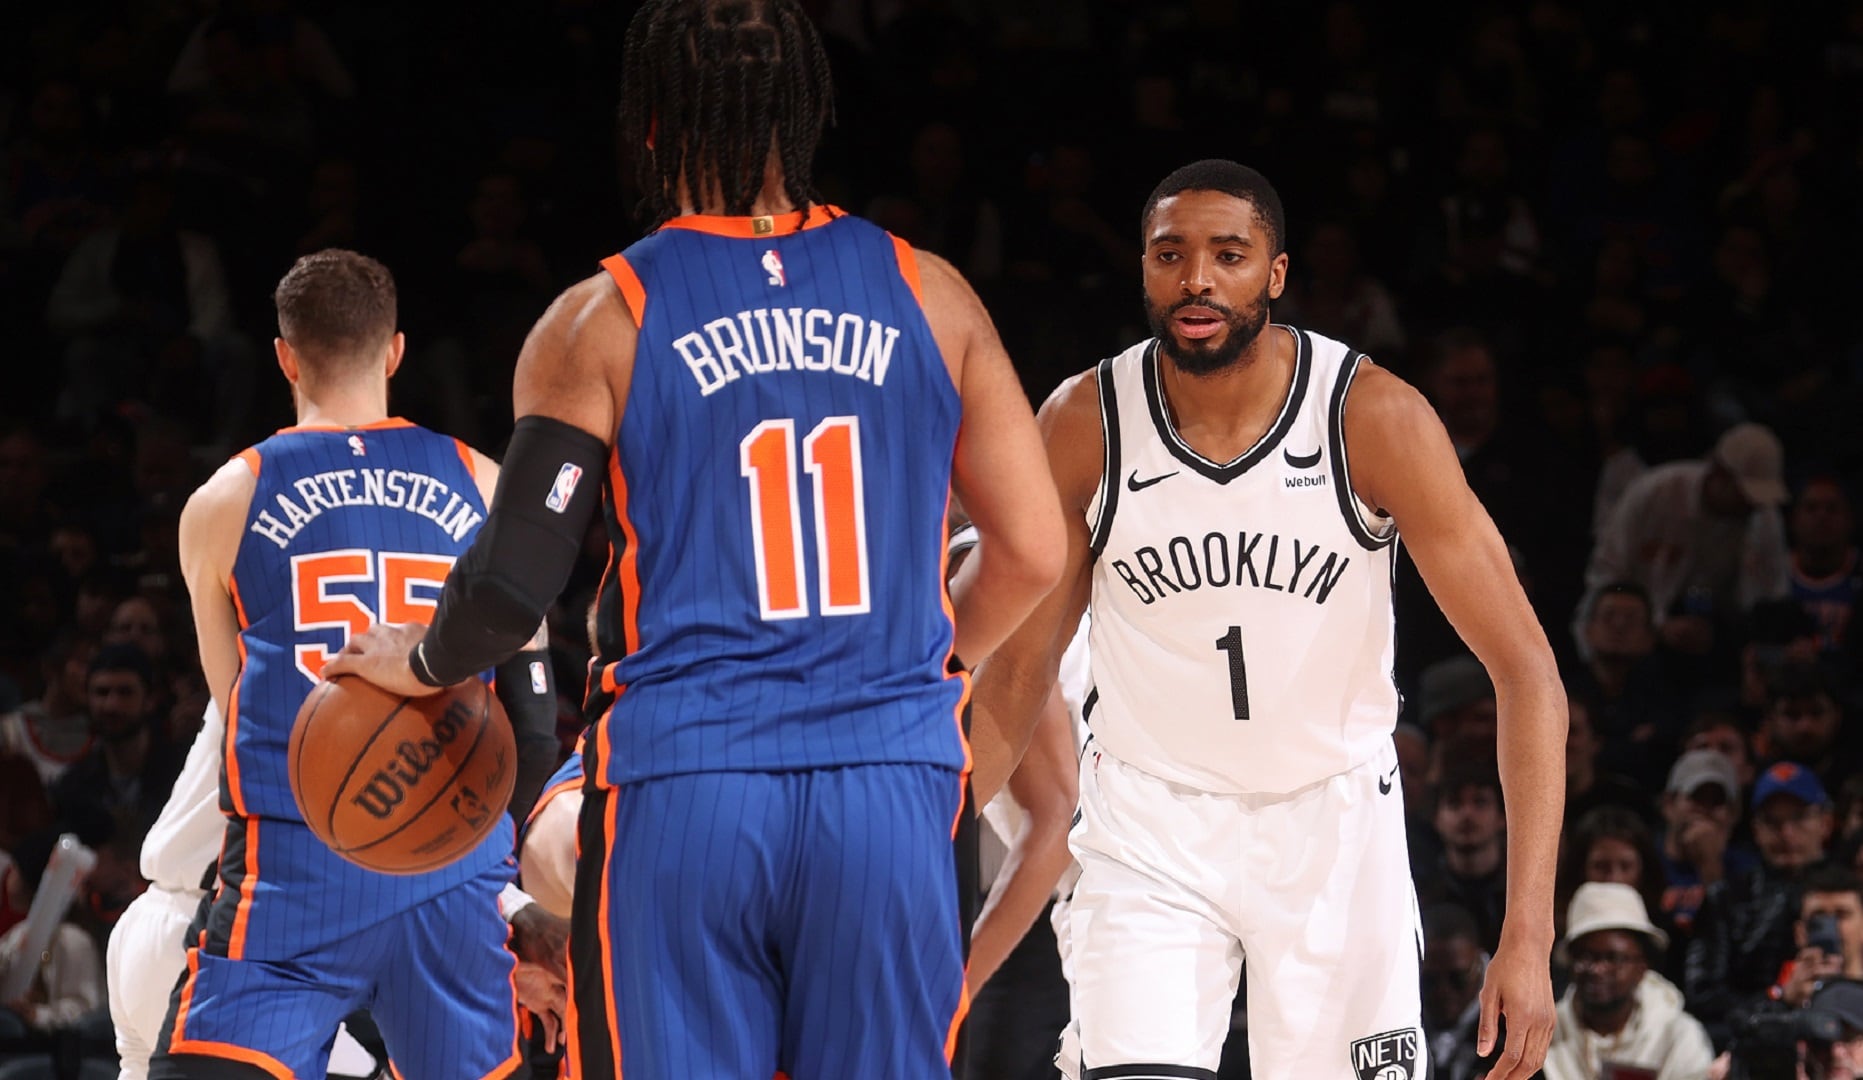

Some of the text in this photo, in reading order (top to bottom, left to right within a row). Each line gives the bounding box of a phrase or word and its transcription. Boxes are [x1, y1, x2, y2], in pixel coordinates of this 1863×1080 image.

[672, 308, 900, 397] BRUNSON
[251, 469, 482, 549] HARTENSTEIN
[740, 416, 871, 621] 11
[1284, 474, 1326, 488] Webull
[1112, 531, 1350, 605] BROOKLYN
[1216, 626, 1250, 720] 1
[352, 700, 474, 820] Wilson
[1359, 1032, 1417, 1070] NETS
